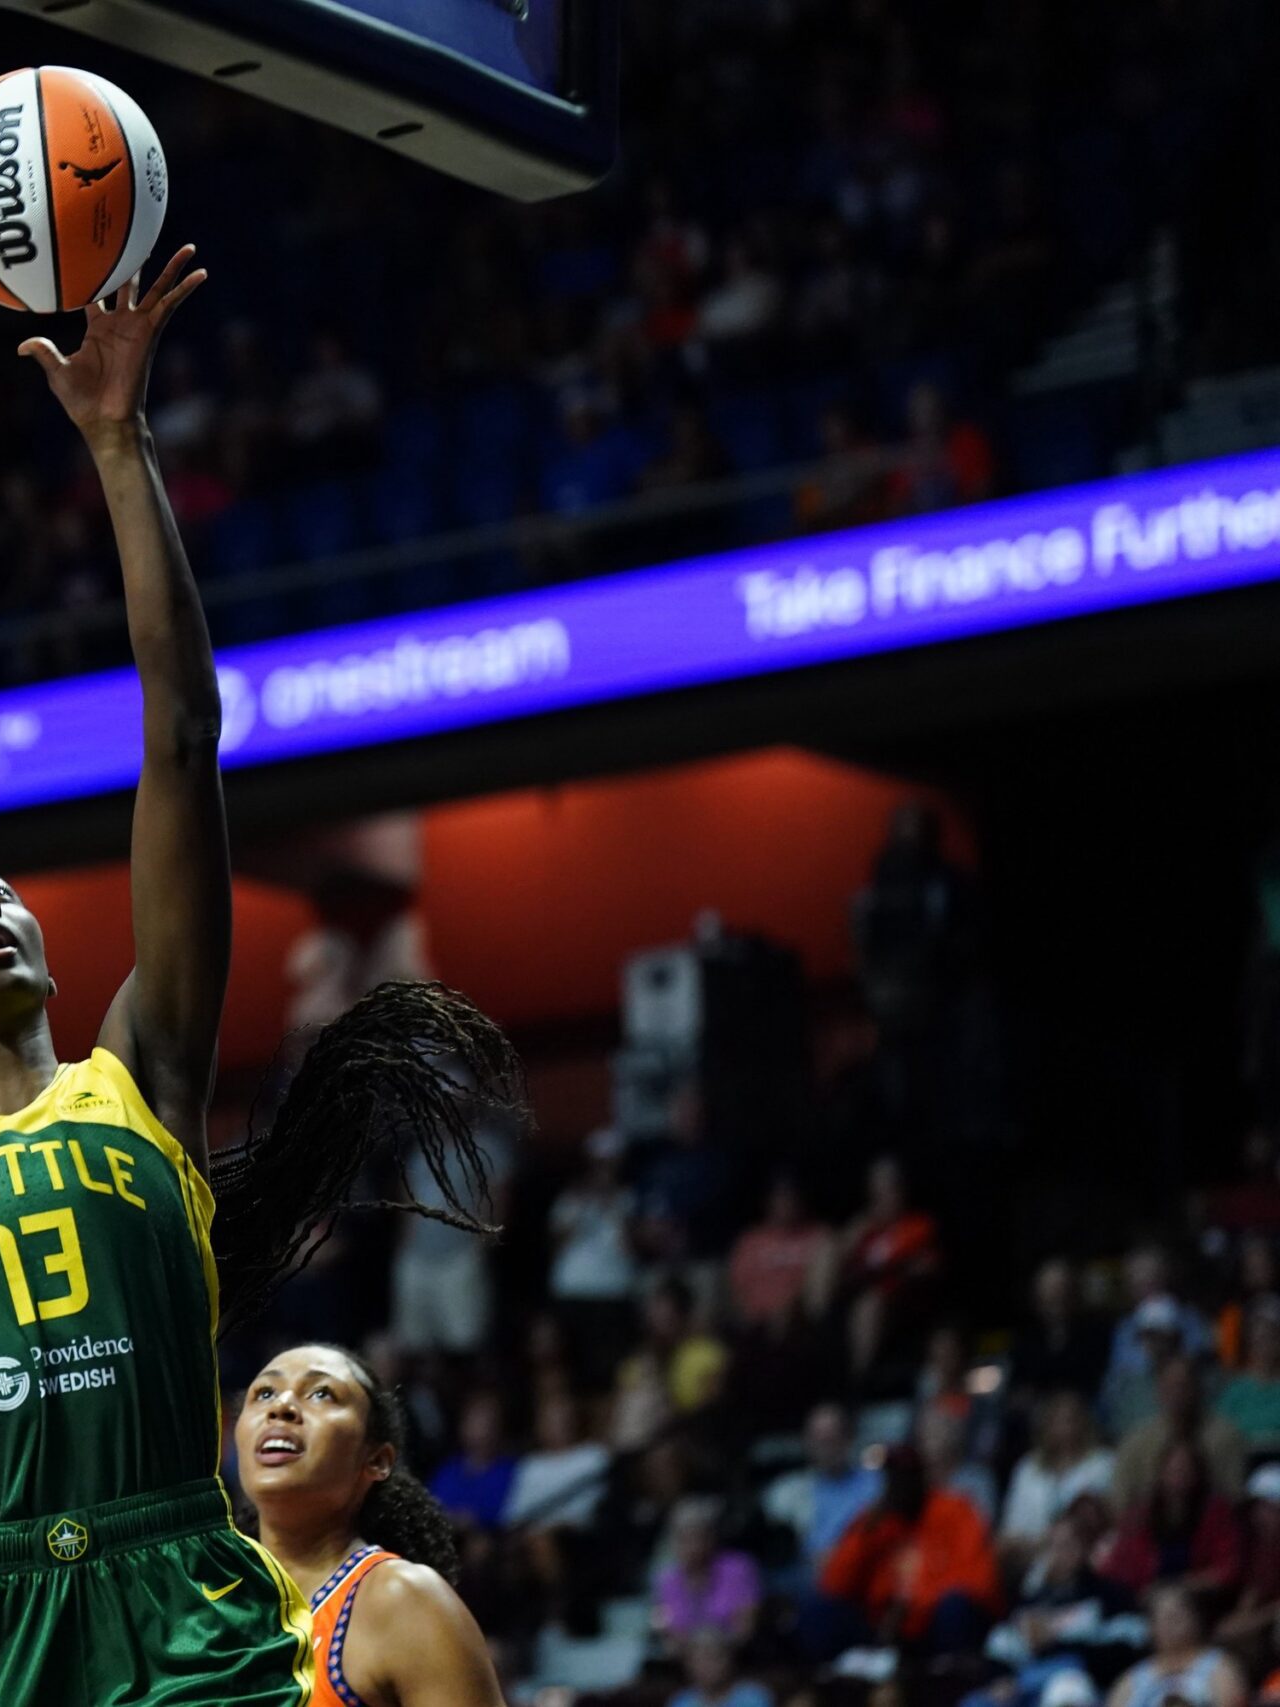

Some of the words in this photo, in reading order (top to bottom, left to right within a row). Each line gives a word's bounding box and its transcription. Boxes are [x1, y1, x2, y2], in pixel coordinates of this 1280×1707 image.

[737, 566, 867, 642] Take
[870, 532, 1087, 619] Finance
[1091, 486, 1280, 579] Furthe
[261, 617, 571, 730] onestream
